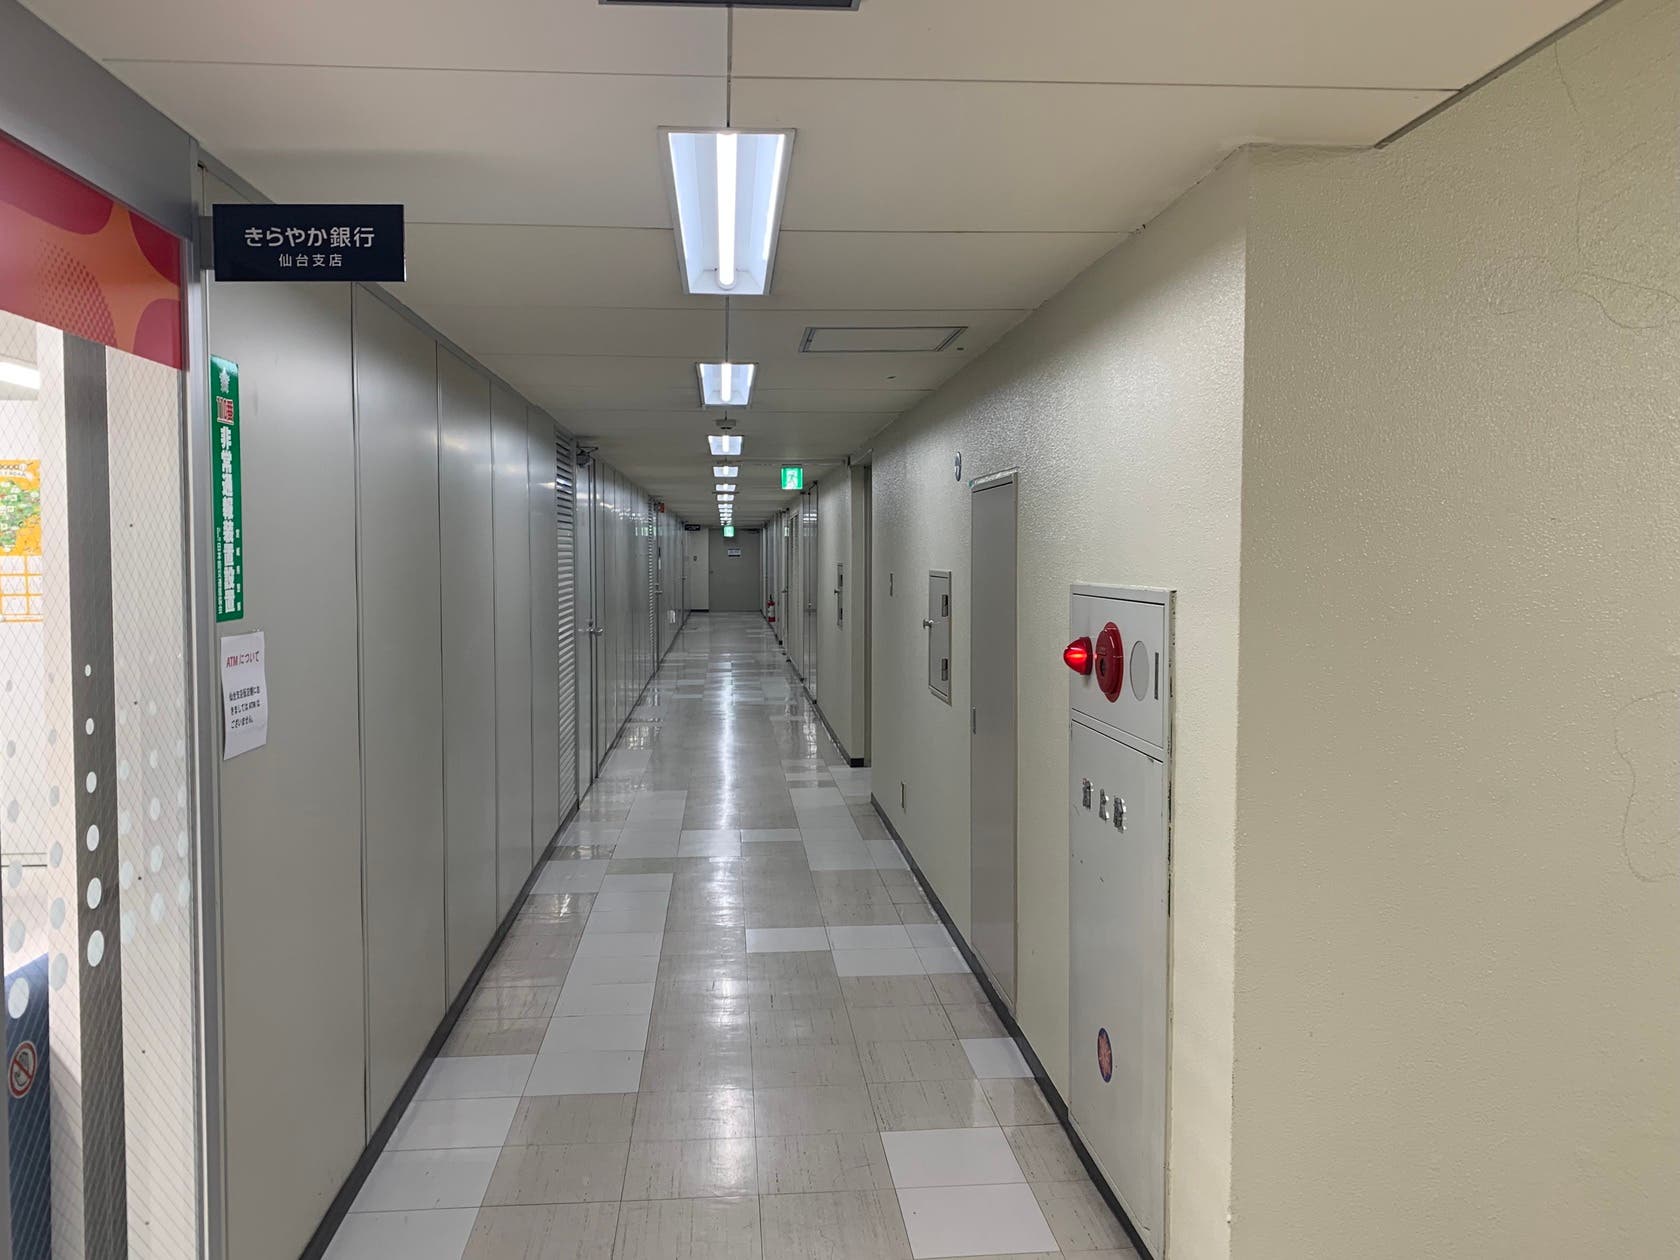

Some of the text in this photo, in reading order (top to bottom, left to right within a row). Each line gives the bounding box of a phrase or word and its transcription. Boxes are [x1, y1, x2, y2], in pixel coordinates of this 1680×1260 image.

[244, 227, 375, 248] きらやか銀行
[278, 253, 343, 267] 仙台支店
